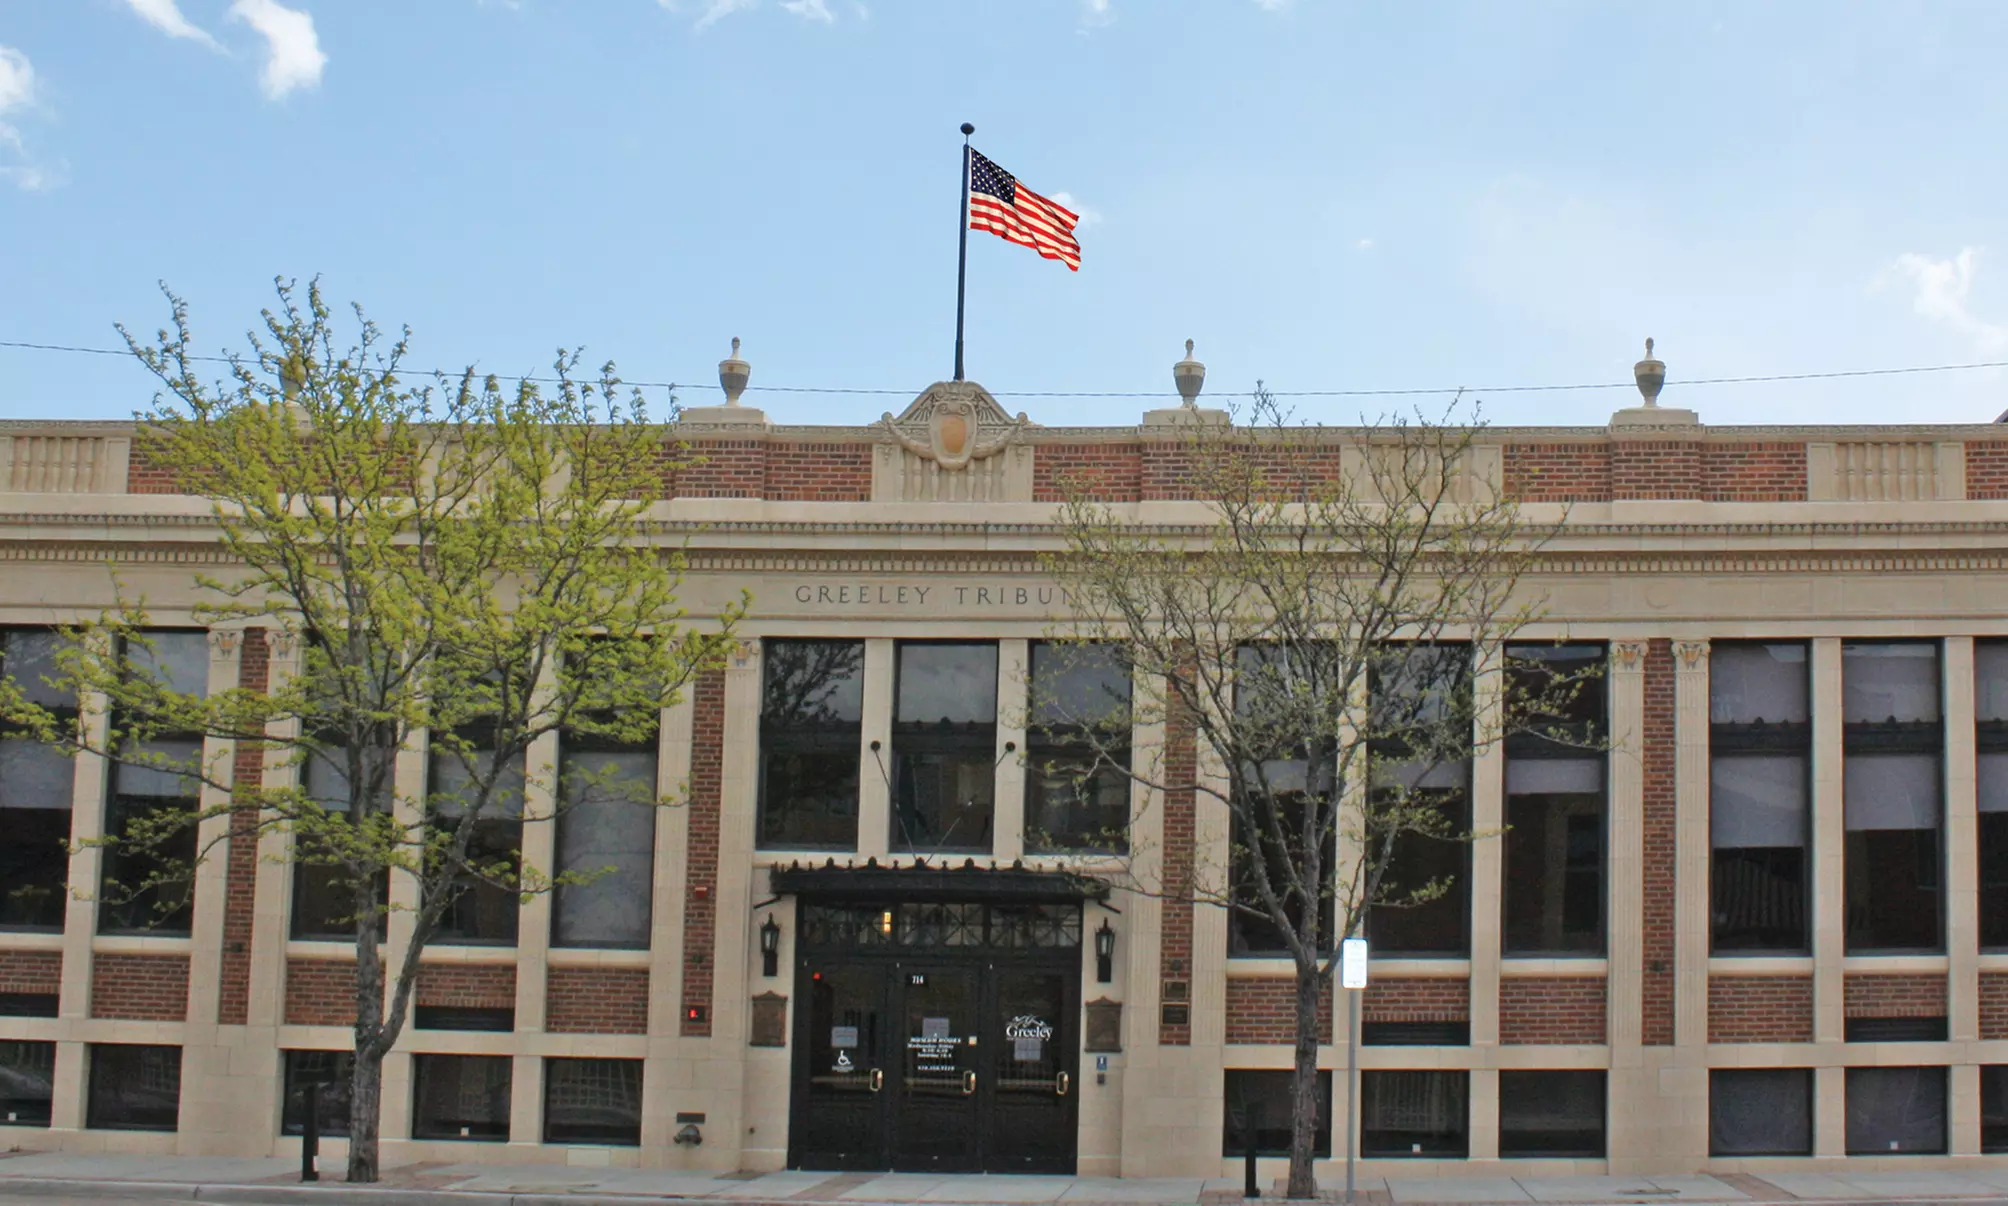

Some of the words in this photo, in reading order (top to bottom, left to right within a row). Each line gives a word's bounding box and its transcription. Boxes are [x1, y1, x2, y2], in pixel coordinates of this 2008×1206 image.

[795, 585, 931, 604] GREELEY
[954, 587, 1088, 605] TRIBUN
[1005, 1024, 1053, 1041] Greeley
